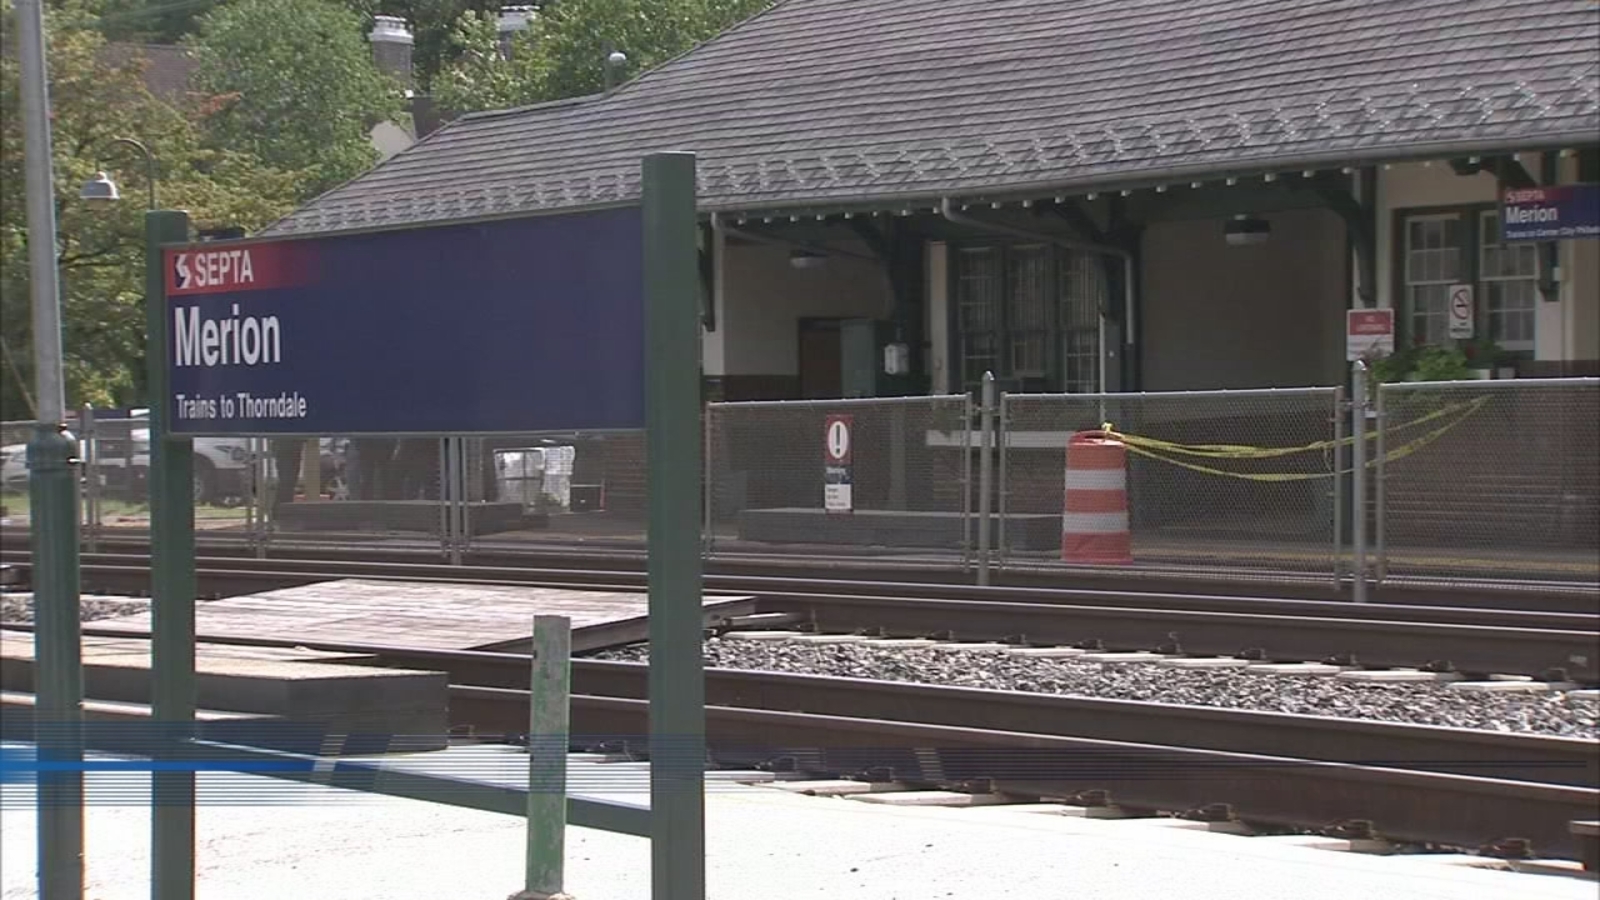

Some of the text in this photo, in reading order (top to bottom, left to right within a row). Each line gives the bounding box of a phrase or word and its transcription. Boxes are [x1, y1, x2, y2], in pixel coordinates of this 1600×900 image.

[1506, 205, 1557, 224] Merion
[194, 250, 254, 287] SEPTA
[175, 303, 280, 367] Merion
[176, 391, 307, 419] Trains to Thorndale
